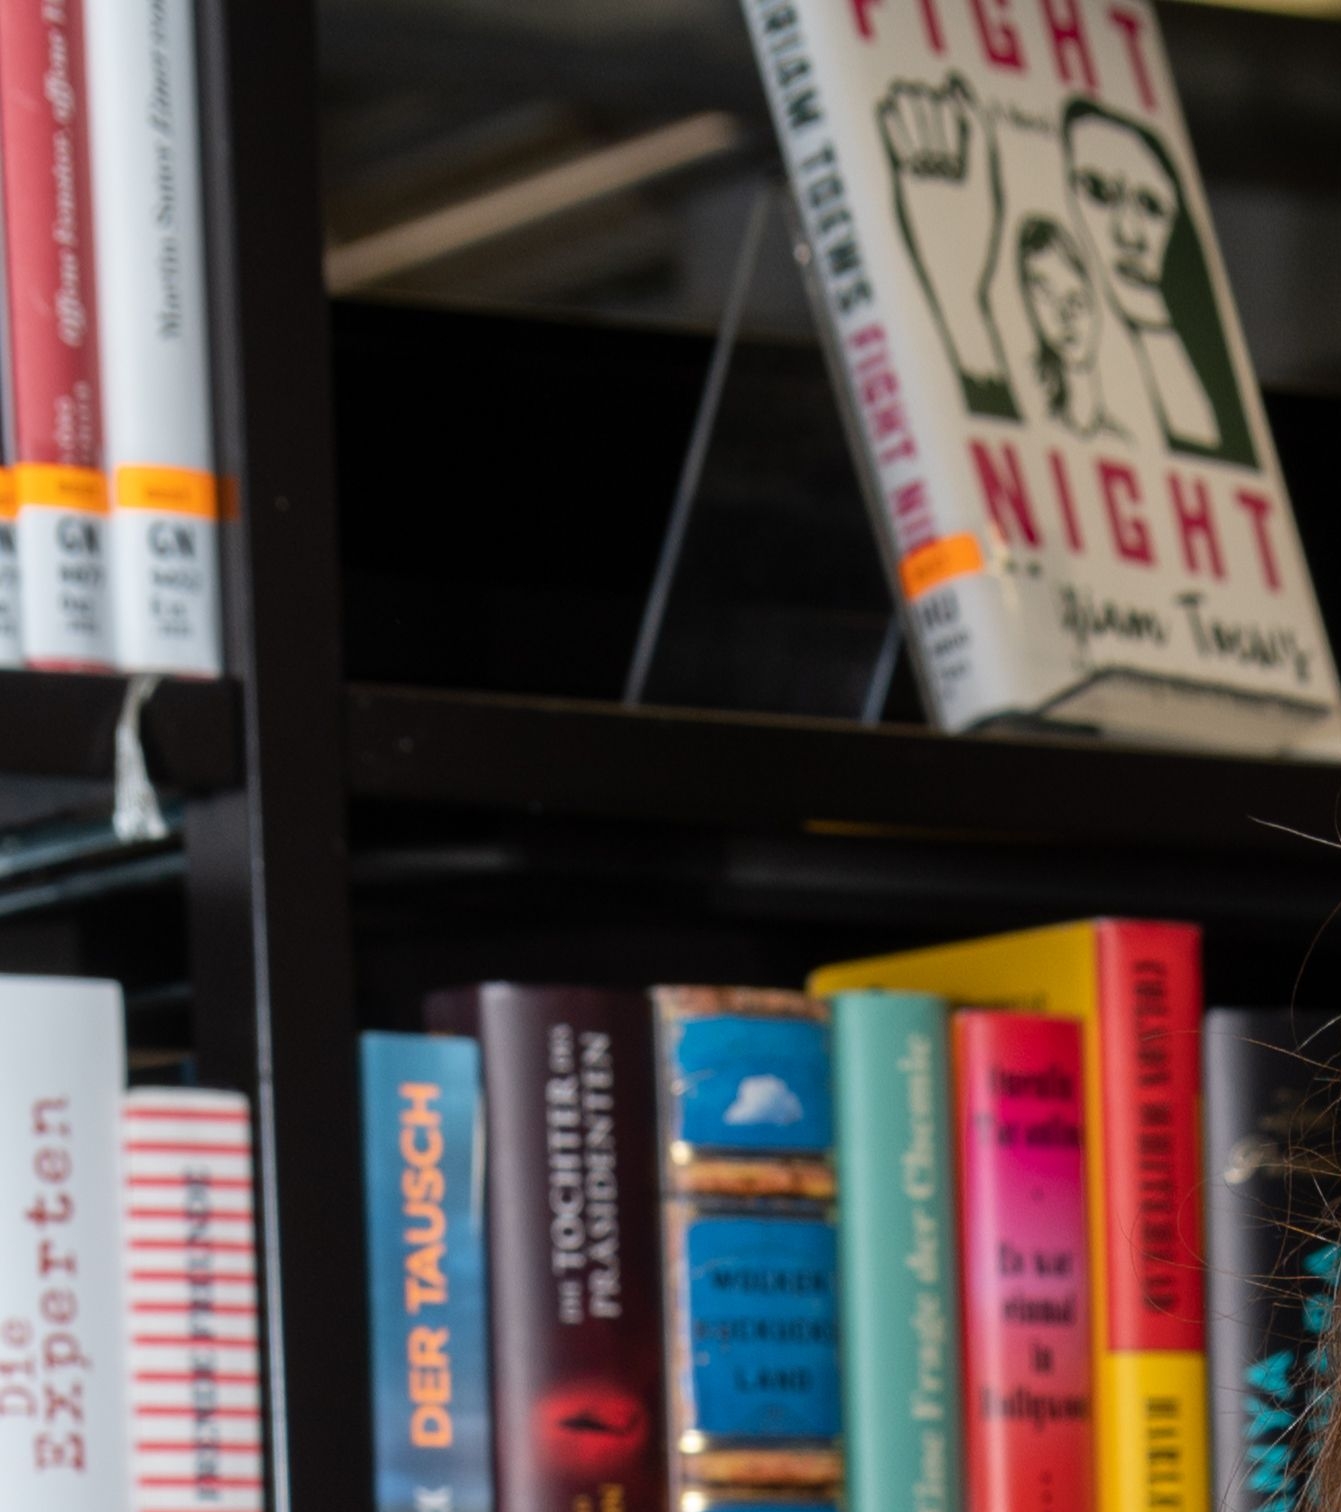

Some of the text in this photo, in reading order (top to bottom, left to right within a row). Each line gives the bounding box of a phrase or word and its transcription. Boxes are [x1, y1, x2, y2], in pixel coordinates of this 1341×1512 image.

[850, 325, 919, 466] FIGHT
[969, 437, 1283, 593] NIGHT
[551, 1073, 587, 1273] TOCHTER
[897, 1029, 938, 1201] Chemie
[399, 1081, 451, 1314] TAUSCH
[905, 1210, 938, 1285] der
[29, 1096, 88, 1475] Experten
[910, 1296, 952, 1422] Frage
[409, 1318, 454, 1450] DER
[733, 1365, 815, 1394] LAND
